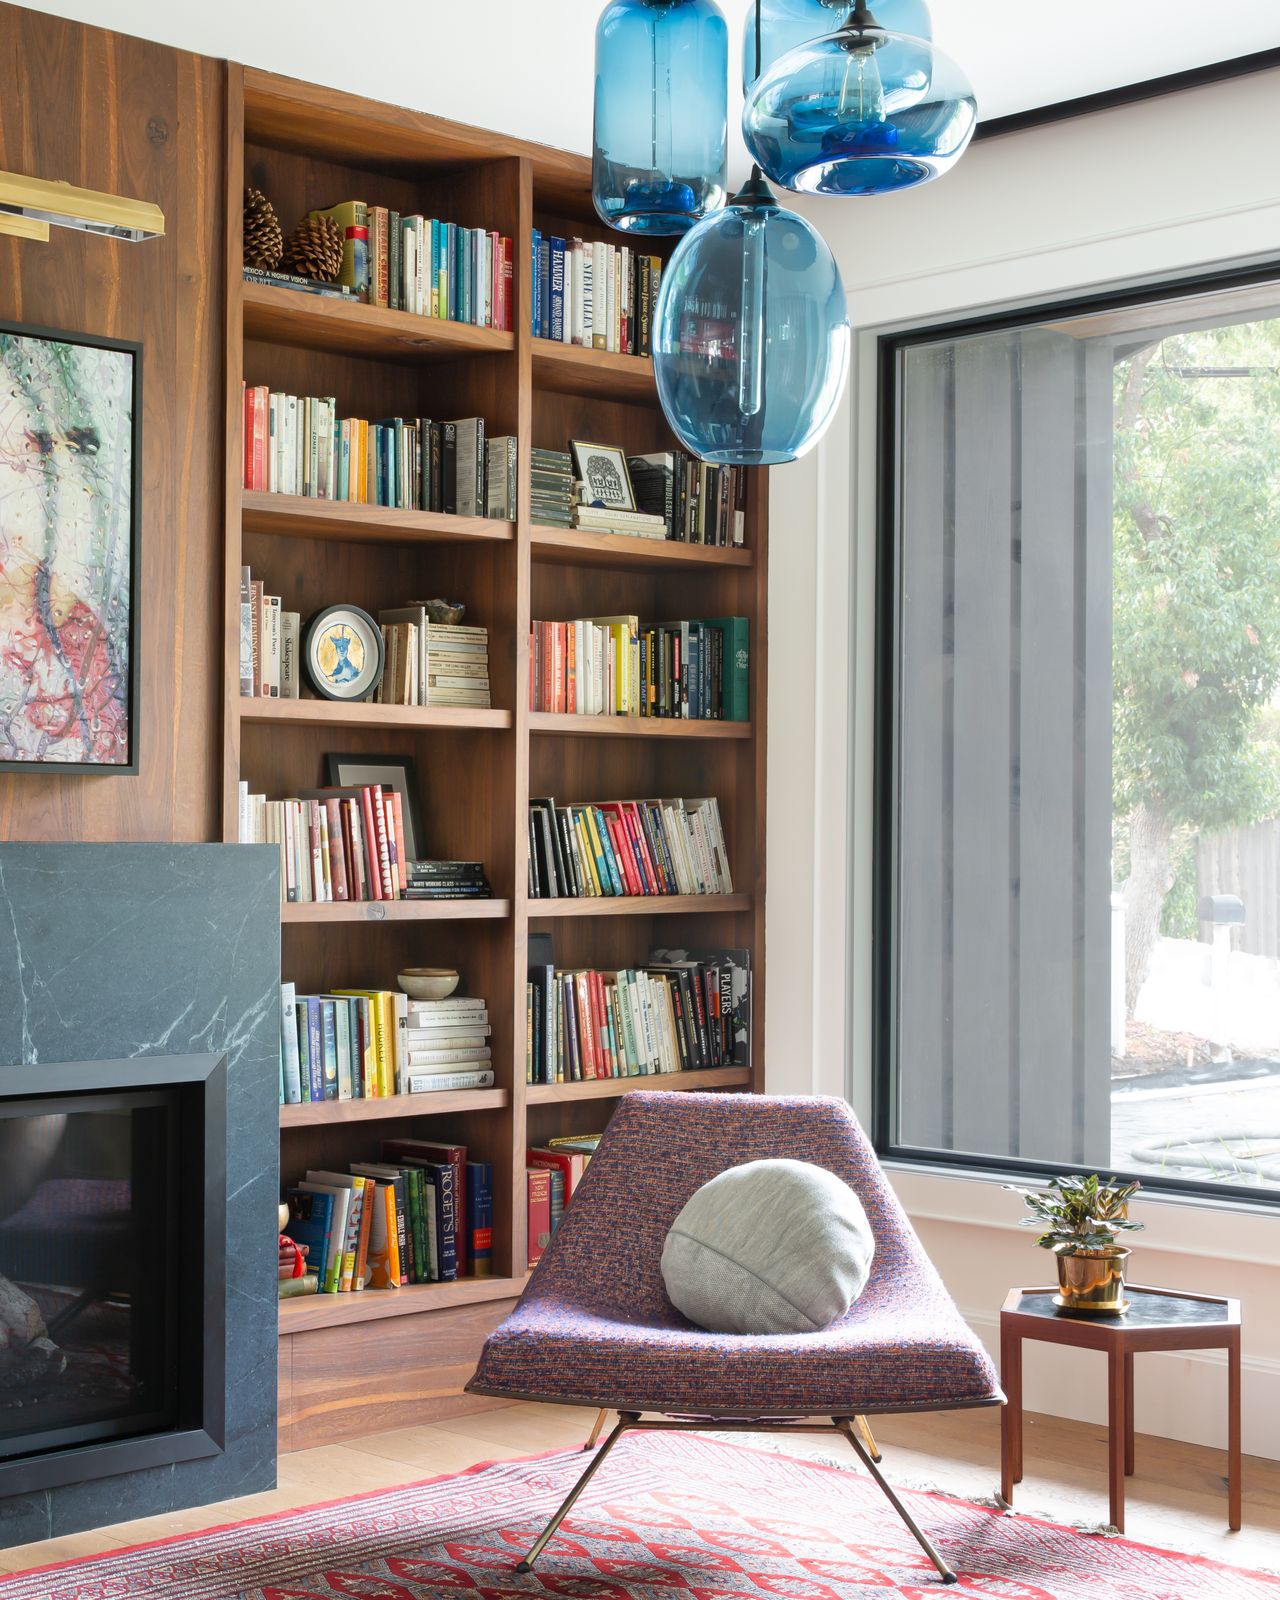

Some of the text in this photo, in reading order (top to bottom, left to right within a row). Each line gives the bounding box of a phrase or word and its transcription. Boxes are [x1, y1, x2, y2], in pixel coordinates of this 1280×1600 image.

[271, 272, 289, 281] HIGHER
[290, 276, 308, 285] VISION
[553, 250, 563, 291] HAMMER
[584, 264, 593, 329] STEVE ALLEN
[283, 637, 292, 681] Shakespeare
[721, 974, 732, 1014] PLAYERS
[532, 1160, 560, 1169] DICTIONARY
[398, 1215, 406, 1234] EDIBLE
[441, 1170, 454, 1245] ROGET'S II
